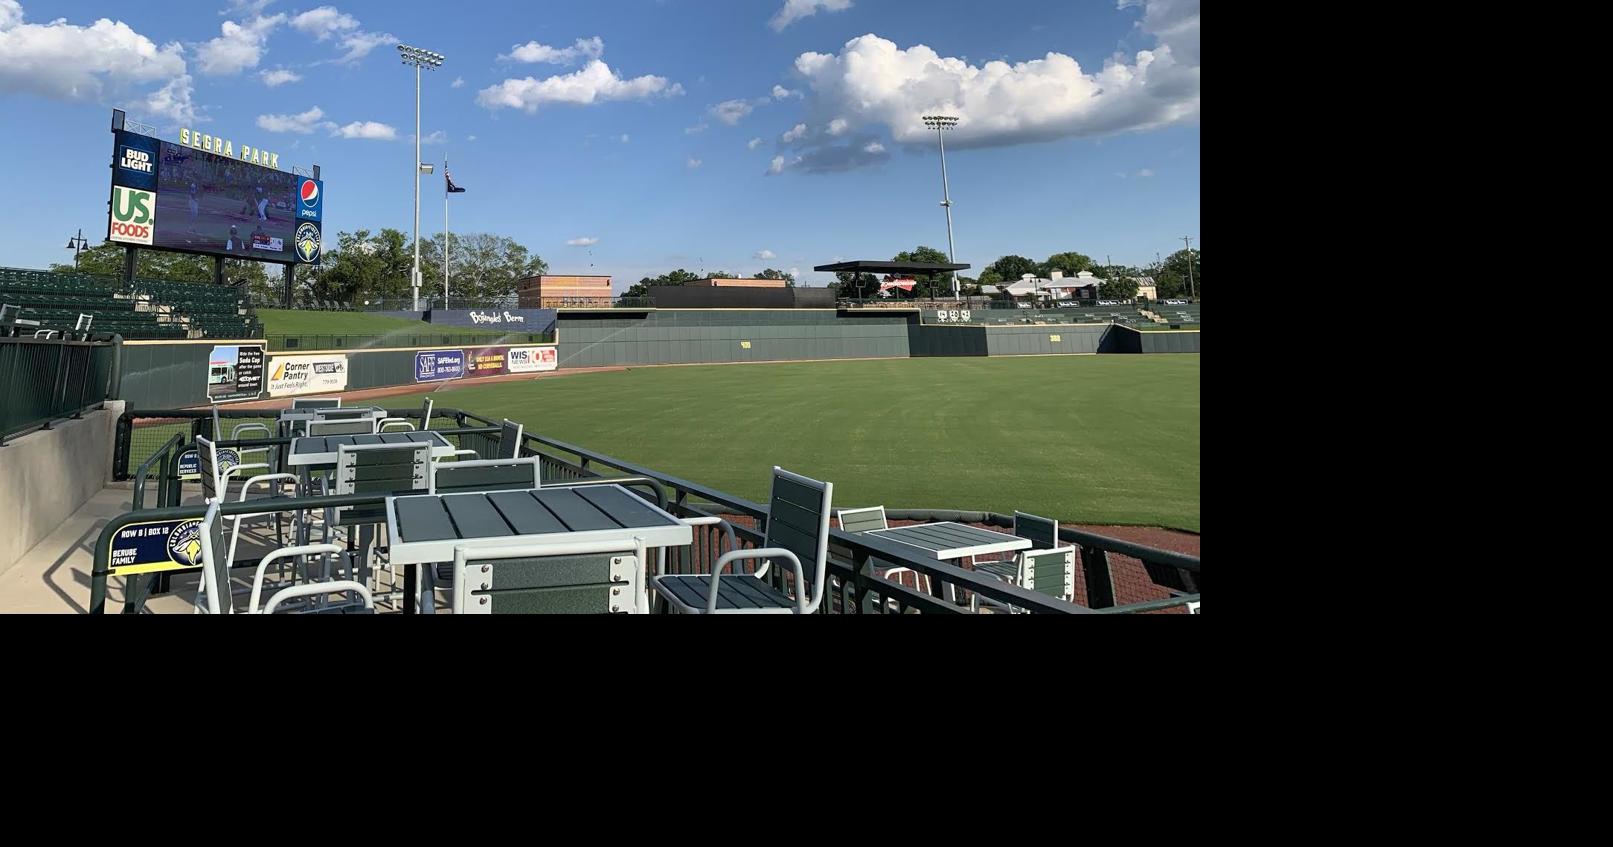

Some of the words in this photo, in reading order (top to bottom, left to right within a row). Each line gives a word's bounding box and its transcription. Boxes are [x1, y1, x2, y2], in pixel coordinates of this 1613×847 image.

[180, 127, 233, 157] SEGRA
[241, 144, 279, 168] PARK
[126, 148, 149, 162] BUD
[121, 156, 153, 173] LIGHT
[301, 208, 317, 218] pepsi
[111, 221, 149, 239] FOODS
[503, 310, 524, 323] Berm
[510, 350, 528, 360] WIS
[285, 362, 310, 371] Corner
[420, 356, 435, 373] SAFE
[283, 371, 308, 381] Pantry
[275, 382, 284, 390] Just
[121, 529, 137, 539] ROW
[148, 526, 162, 536] BOX
[162, 526, 170, 536] 12
[112, 548, 138, 558] BERUBE
[111, 556, 136, 566] FAMILY
